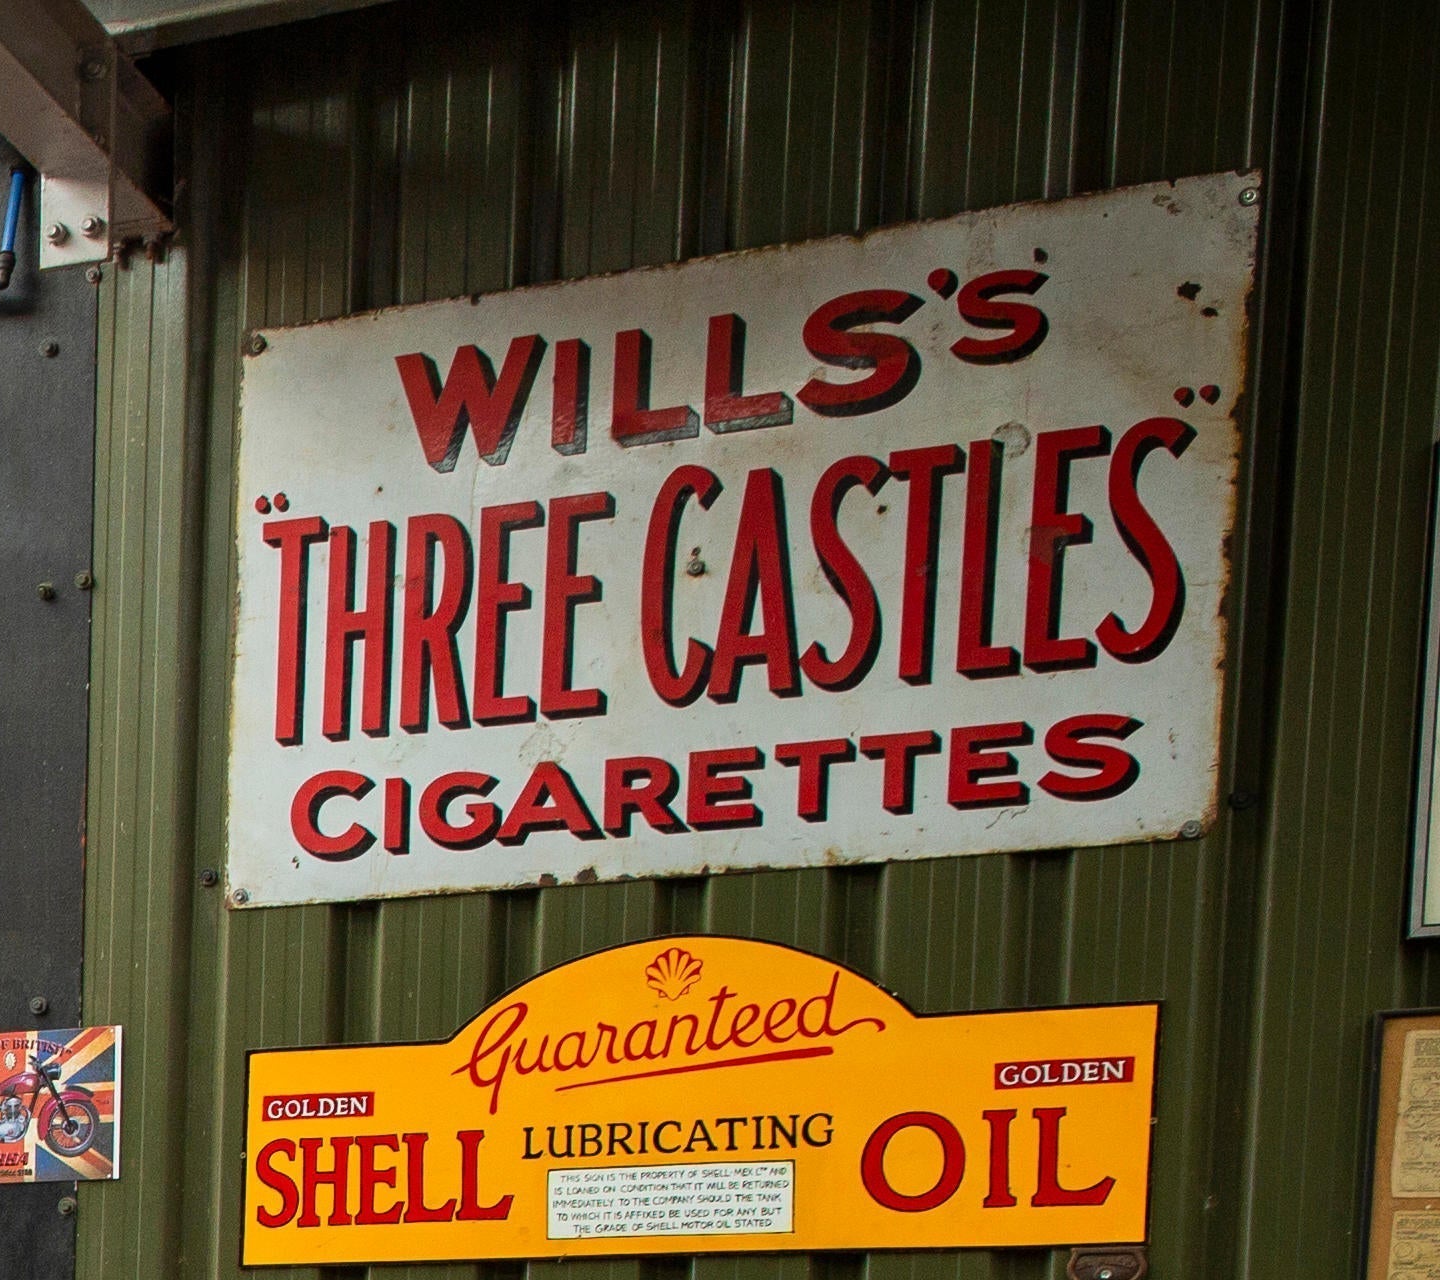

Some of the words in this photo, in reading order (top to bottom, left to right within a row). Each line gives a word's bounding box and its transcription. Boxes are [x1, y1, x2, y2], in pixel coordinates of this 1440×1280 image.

[291, 713, 1143, 863] CIGARETTES
[452, 969, 886, 1116] Guaranteed
[998, 1059, 1127, 1088] GOLDEN
[266, 1095, 370, 1120] GOLDEN
[521, 1112, 835, 1162] LUBRICATING
[255, 1128, 515, 1229] SHELL
[859, 1106, 1116, 1213] OIL
